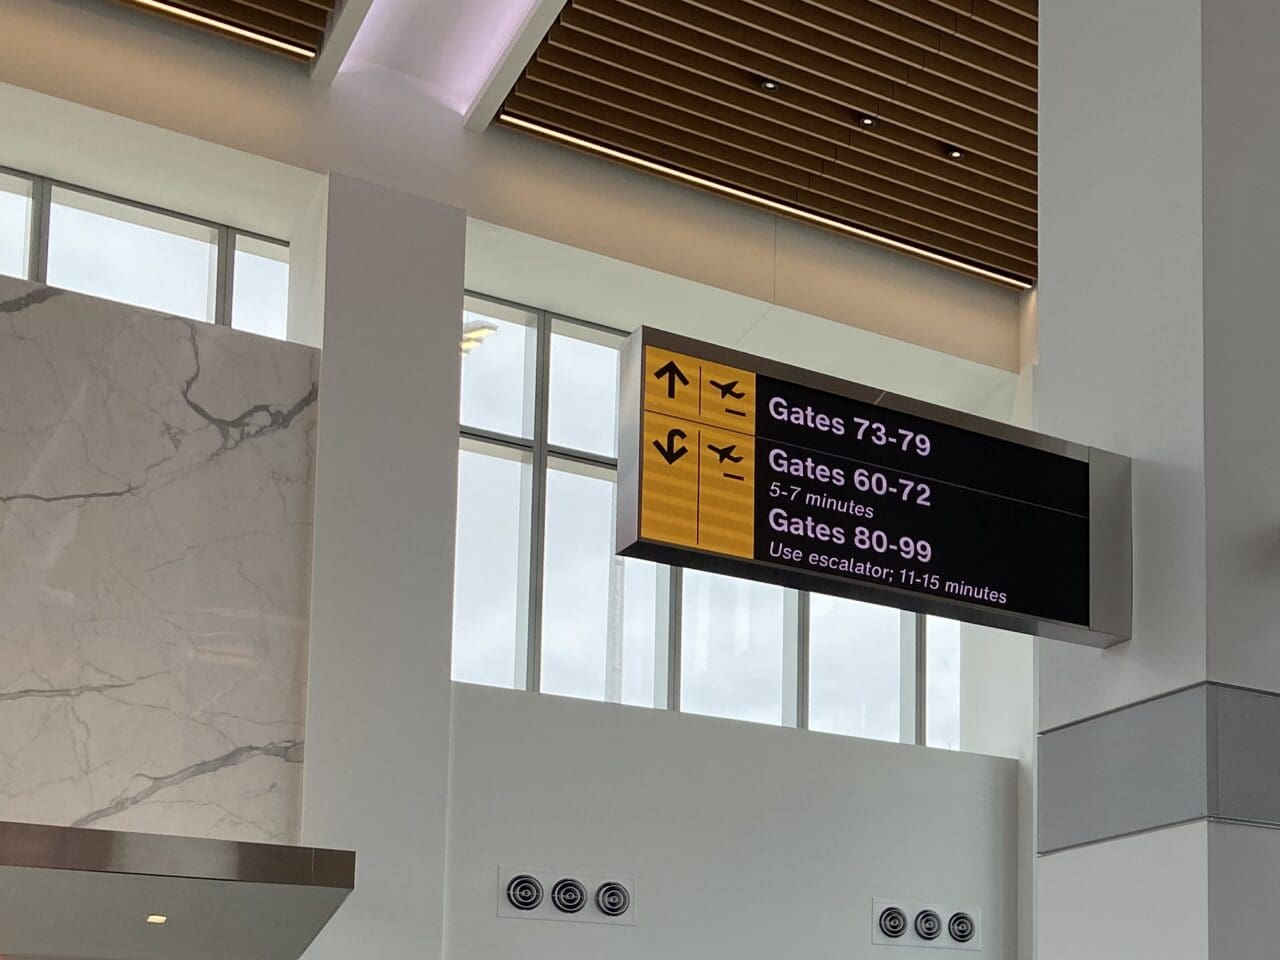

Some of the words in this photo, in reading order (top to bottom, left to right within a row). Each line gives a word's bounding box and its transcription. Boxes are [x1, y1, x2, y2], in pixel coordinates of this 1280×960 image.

[768, 396, 846, 435] Gates
[853, 417, 932, 456] 73-79
[768, 448, 846, 486] Gates
[853, 468, 932, 507] 60-72
[769, 482, 802, 501] 5-7
[805, 493, 875, 518] minutes
[768, 508, 846, 544] Gates
[853, 526, 932, 563] 80-99
[769, 541, 803, 561] Use
[808, 552, 894, 583] escalator;
[899, 569, 940, 590] 11-15
[945, 579, 1008, 604] minutes
